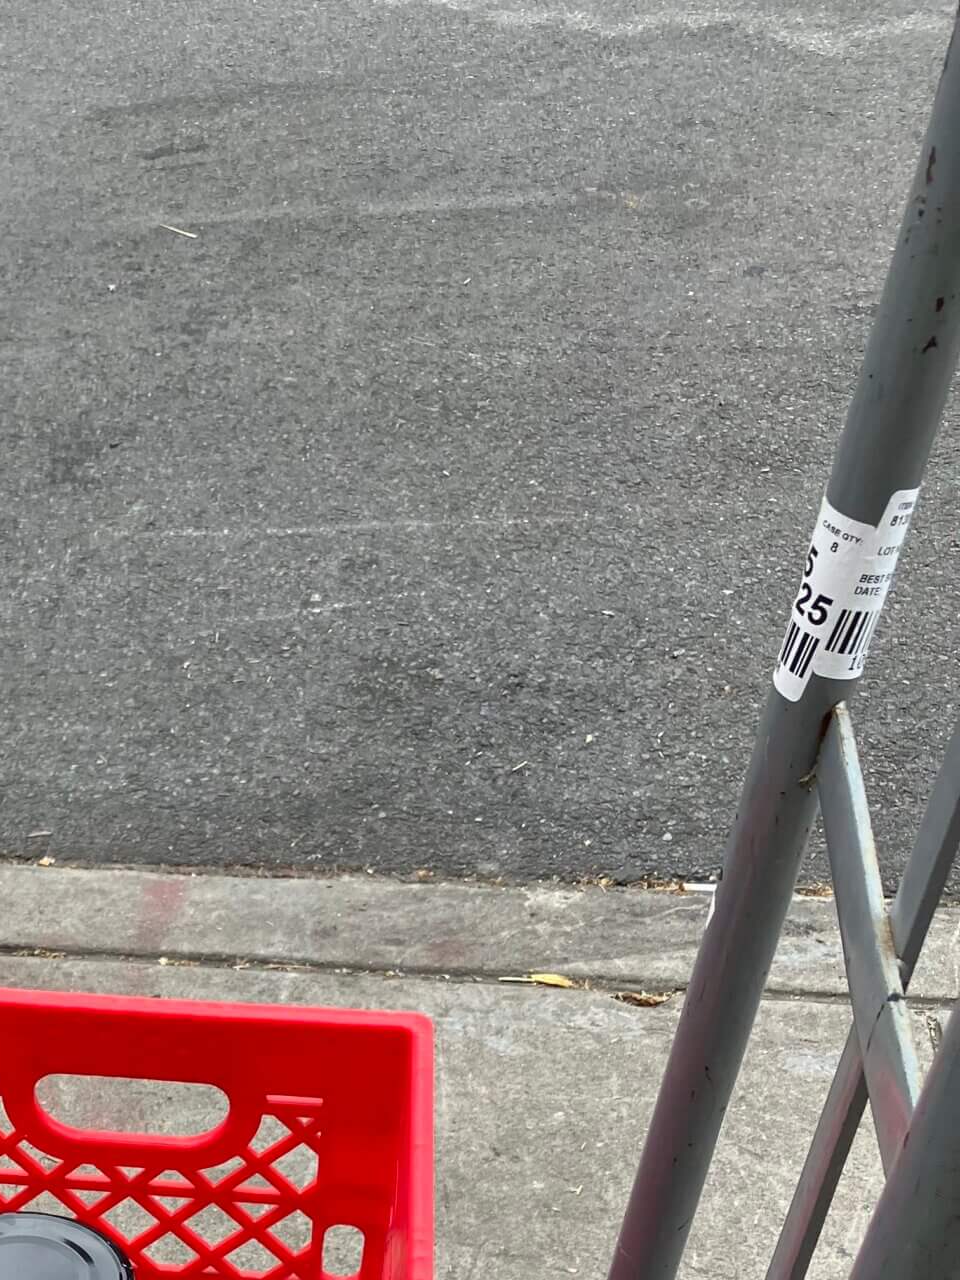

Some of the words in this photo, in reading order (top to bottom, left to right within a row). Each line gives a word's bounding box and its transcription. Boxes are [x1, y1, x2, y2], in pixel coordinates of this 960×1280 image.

[823, 519, 841, 537] CASE
[830, 542, 839, 553] 8
[859, 574, 885, 584] BEST
[795, 582, 834, 626] 25
